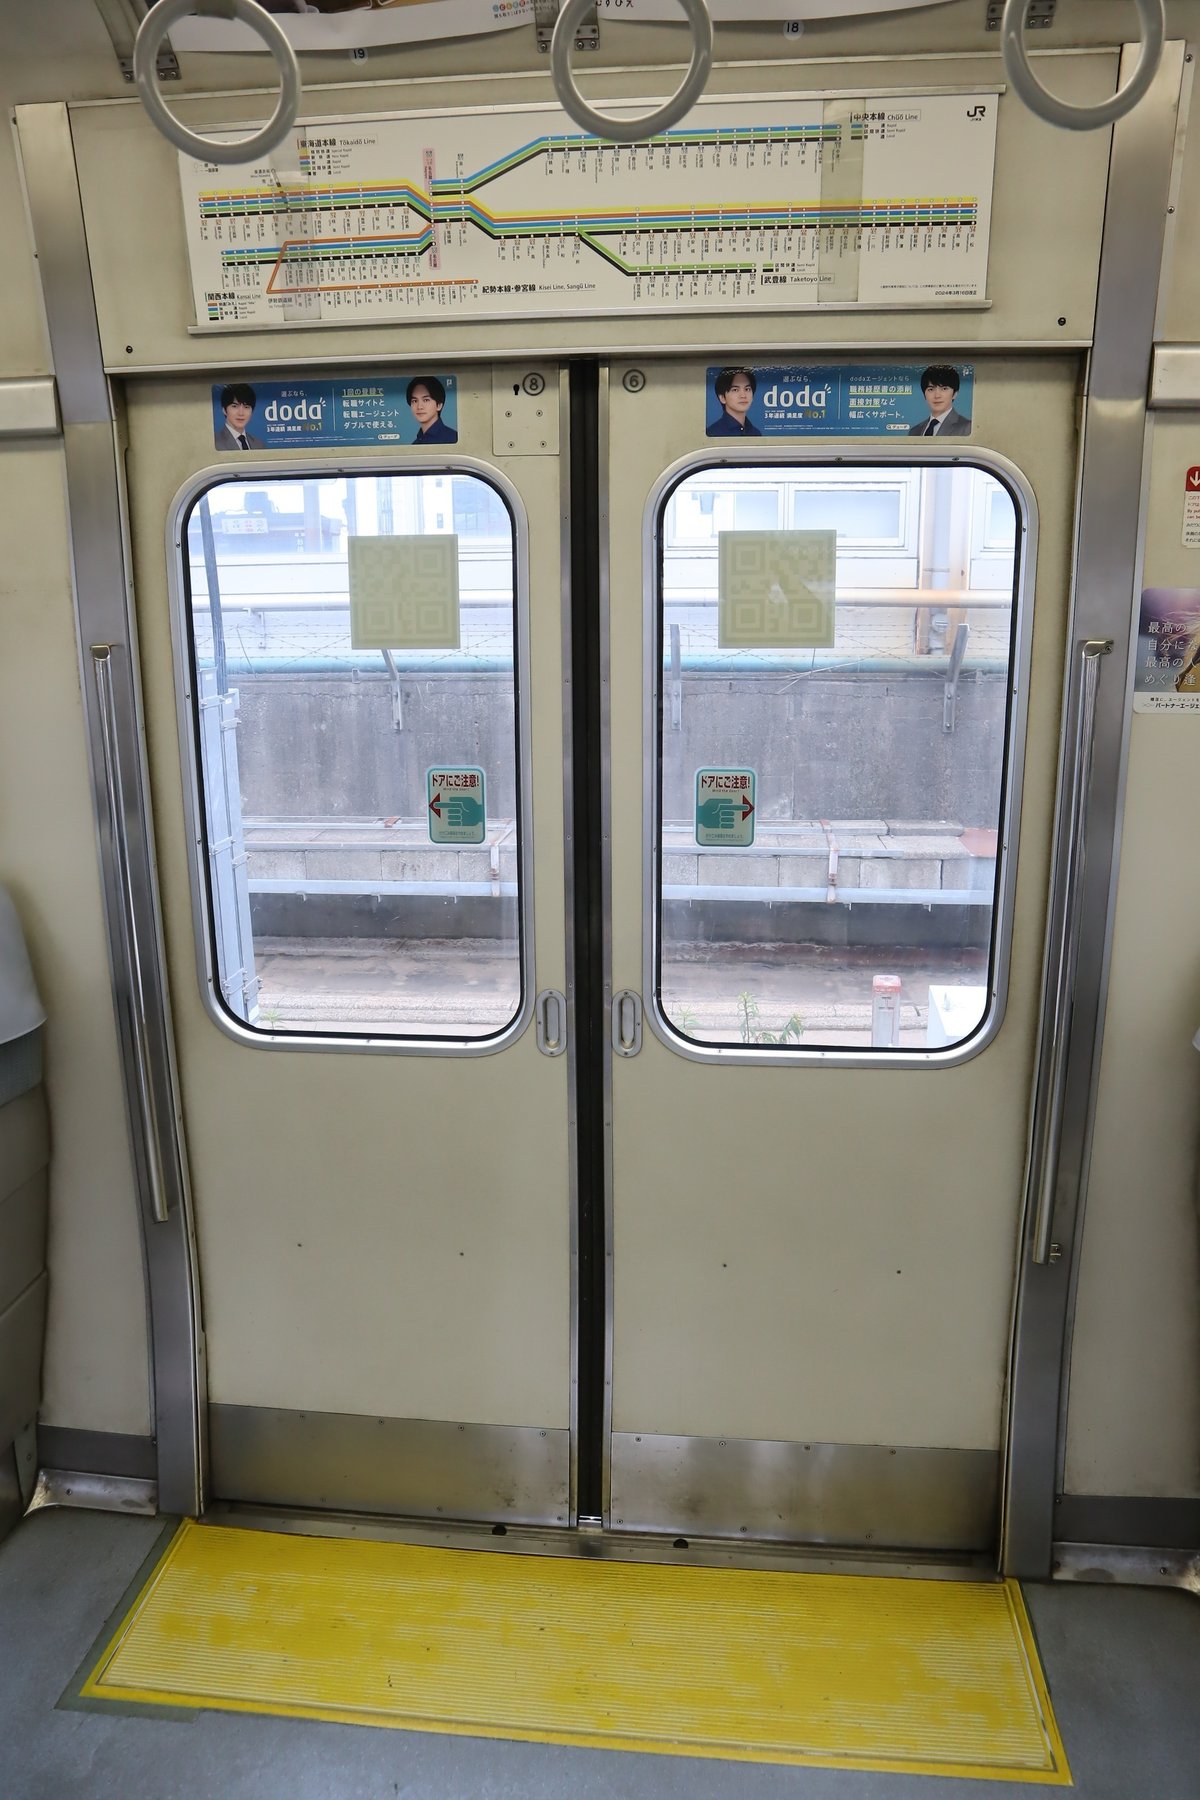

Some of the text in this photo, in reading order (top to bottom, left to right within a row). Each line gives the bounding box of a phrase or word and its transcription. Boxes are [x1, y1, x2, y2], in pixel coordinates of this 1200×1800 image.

[786, 22, 799, 33] 18
[353, 49, 365, 59] 19
[966, 105, 986, 117] JR
[853, 112, 886, 121] 中央本線
[300, 138, 336, 148] 東海道本線
[764, 275, 787, 284] 武豊線
[790, 276, 818, 285] Taketoyo
[208, 292, 235, 301] 関西本線
[763, 384, 826, 408] doda
[342, 399, 385, 408] 転職サイトと
[849, 398, 896, 407] 面接対策など
[264, 399, 322, 421] doda
[343, 410, 400, 419] 転職エージェント
[848, 411, 905, 419] 幅広くサポート。
[1148, 621, 1187, 634] 最高の
[1144, 674, 1197, 686] めぐり逢
[432, 774, 480, 788] ドアにご注意!
[701, 775, 751, 789] ドアにご注意!
